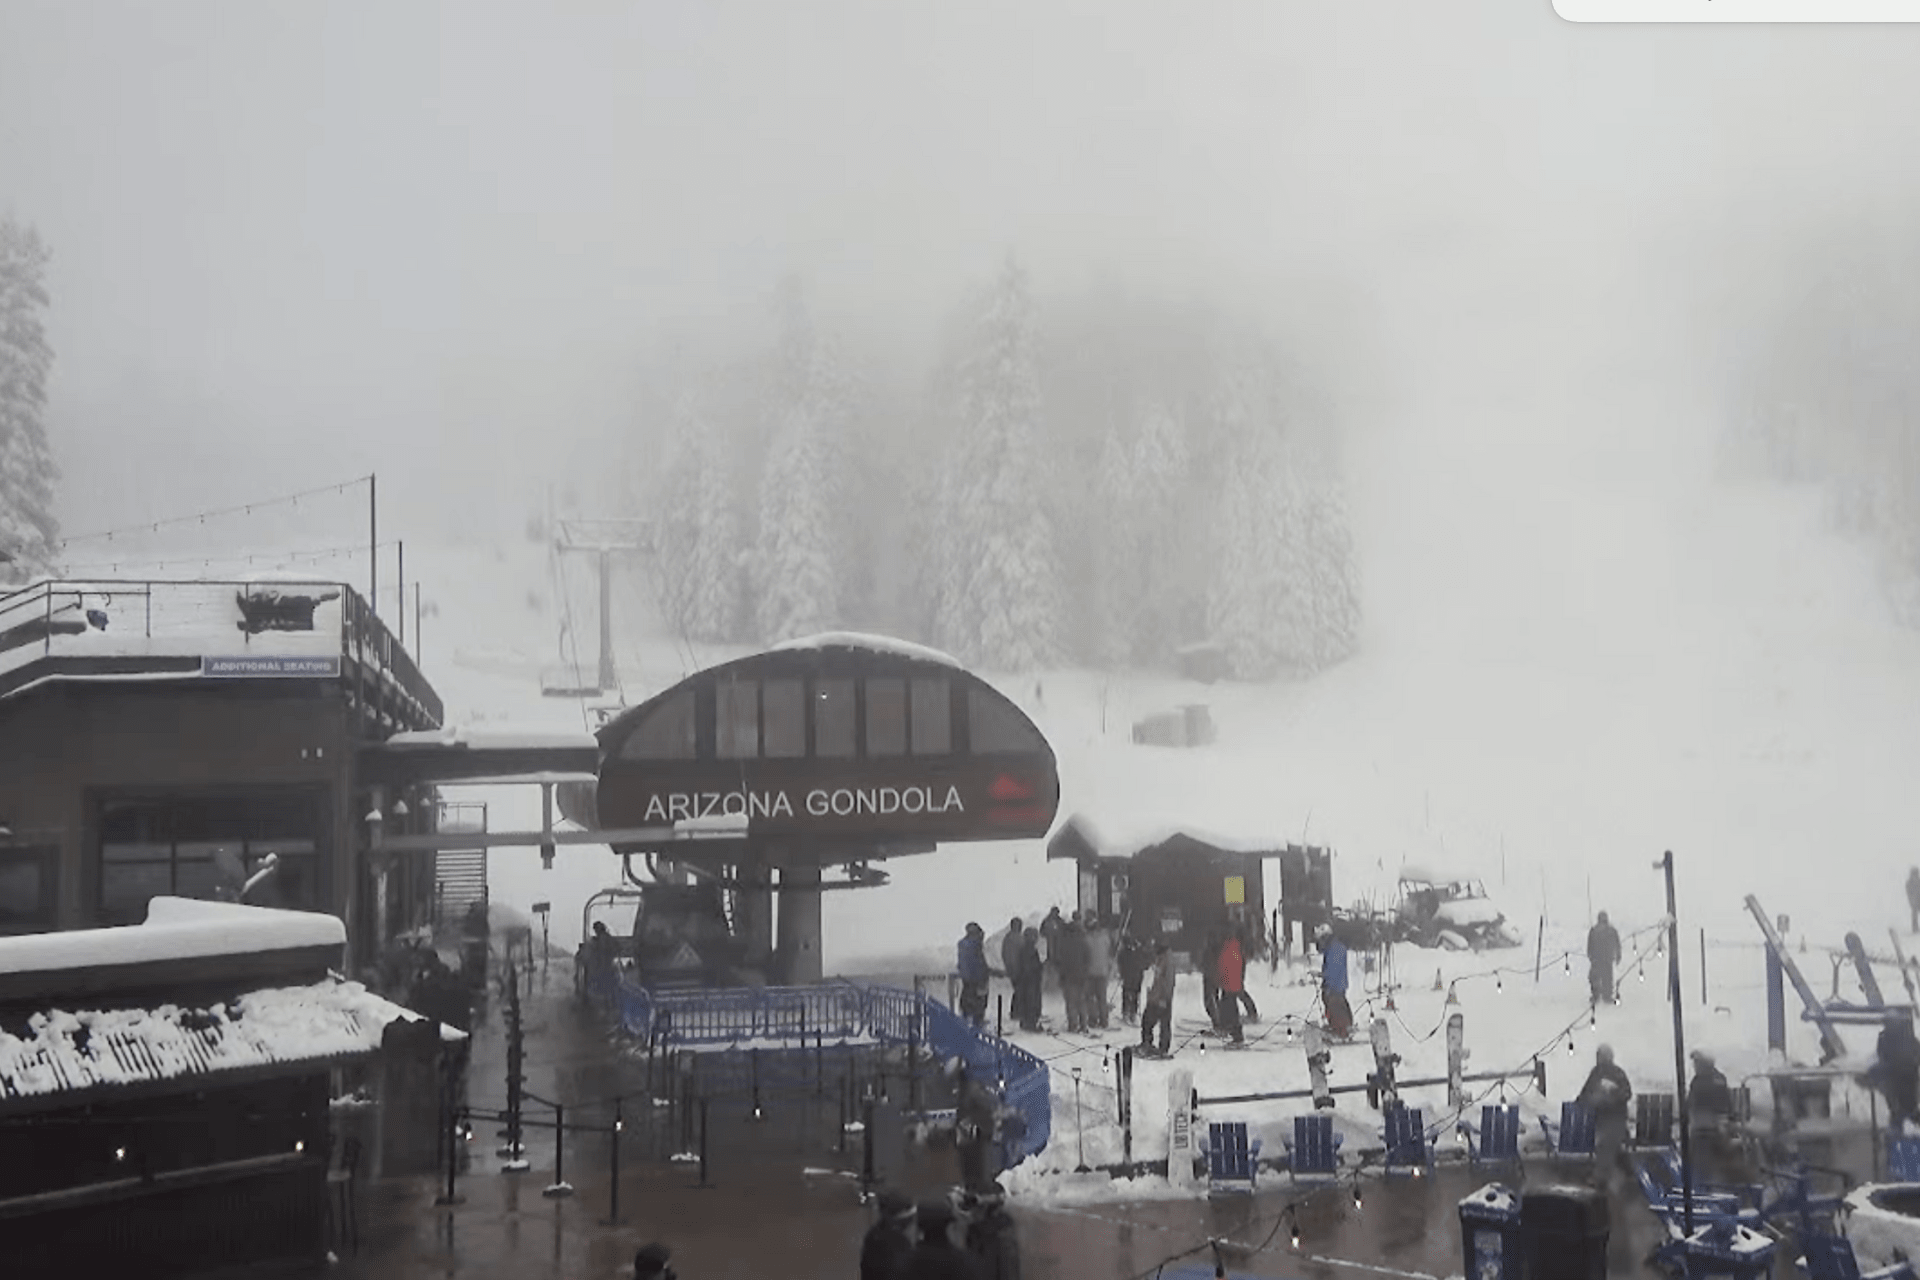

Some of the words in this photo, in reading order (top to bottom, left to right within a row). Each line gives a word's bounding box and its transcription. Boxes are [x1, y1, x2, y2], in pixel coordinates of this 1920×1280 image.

[211, 661, 282, 672] ADDITIONAL
[643, 790, 794, 822] ARIZONA
[805, 785, 965, 816] GONDOLA
